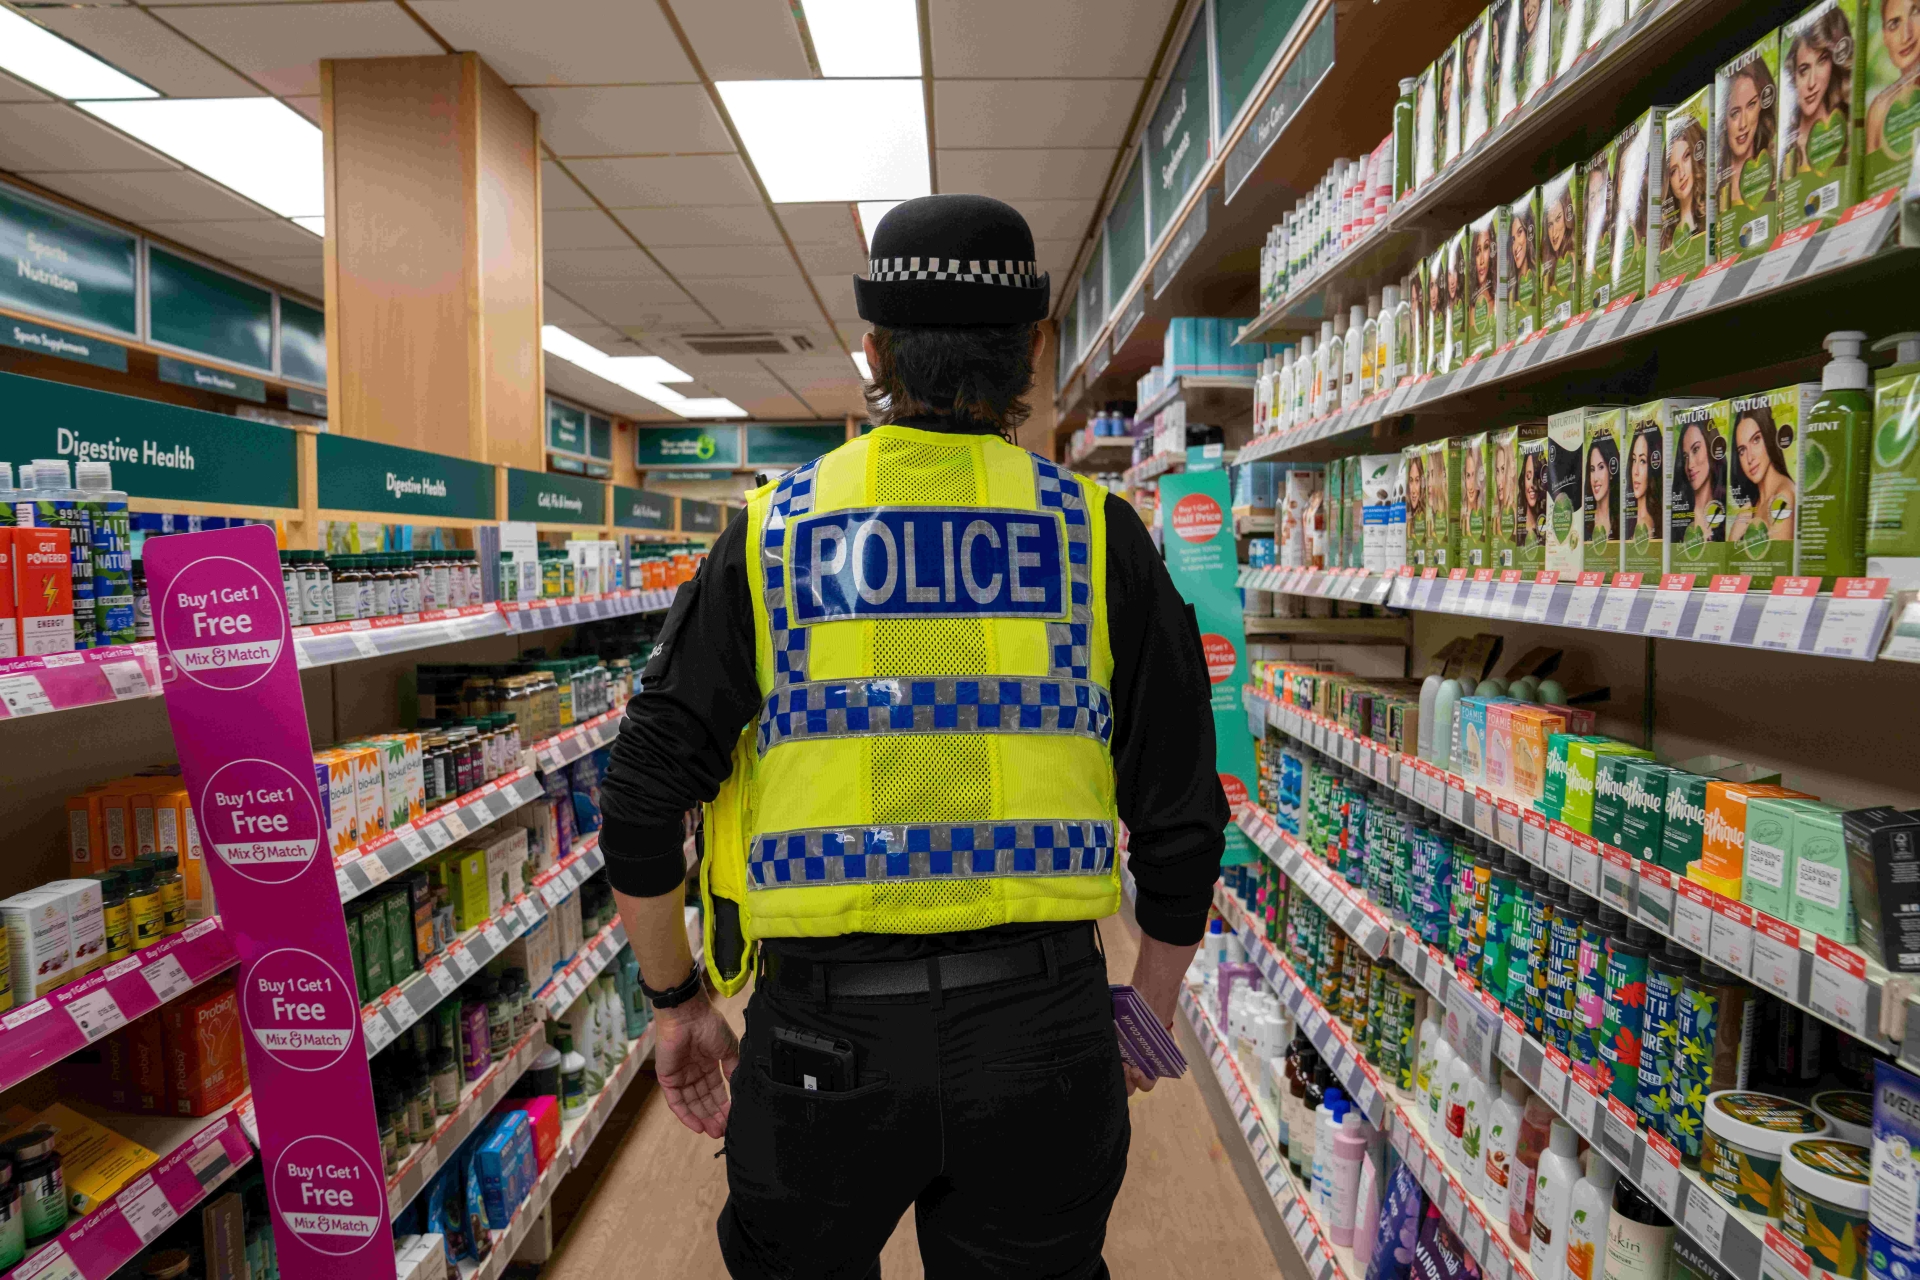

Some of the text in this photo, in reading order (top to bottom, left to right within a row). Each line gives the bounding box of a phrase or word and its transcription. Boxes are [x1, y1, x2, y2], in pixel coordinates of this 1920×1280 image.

[26, 232, 68, 263] Sports
[17, 259, 78, 294] Nutrition
[13, 327, 89, 357] Sports Supplements
[1731, 390, 1794, 414] NATURTINT
[1674, 405, 1727, 426] NATURTINT
[57, 427, 195, 470] Digestive Health
[386, 472, 446, 498] Digestive Health
[1173, 512, 1221, 524] Half Price
[39, 542, 56, 552] GUT
[27, 553, 67, 564] POWERED
[95, 554, 132, 570] NATUR
[811, 519, 1046, 607] POLICE
[1783, 579, 1789, 587] 2
[1789, 578, 1798, 587] for
[1847, 581, 1854, 589] 2
[1854, 580, 1864, 589] for
[178, 585, 259, 611] Buy 1 Get 1
[37, 618, 65, 628] ENERGY
[193, 612, 253, 638] Free
[31, 660, 44, 668] Free
[90, 653, 102, 661] Buy
[107, 651, 117, 659] Get
[120, 649, 133, 657] Free
[186, 646, 270, 667] Mix & Match
[1209, 652, 1235, 663] Price
[1462, 707, 1483, 722] FOAMIE
[1488, 713, 1511, 729] FOAMIE
[1513, 720, 1538, 737] FOAMIE
[1546, 747, 1568, 779] ethiqu
[358, 774, 380, 790] bio-kult
[388, 766, 406, 780] bio-kult
[1566, 763, 1593, 796] ethique
[215, 787, 294, 808] Buy 1 Get 1
[331, 783, 353, 800] bio-kult
[1622, 776, 1661, 814] ethique
[1665, 787, 1705, 826] ethique
[232, 810, 290, 834] Free
[1704, 807, 1745, 850] ethique
[228, 843, 308, 862] Mix & Match
[1750, 845, 1781, 862] CLEANSING
[1750, 853, 1775, 868] SOAP BAR
[1800, 872, 1831, 888] SOAP BAR
[1801, 864, 1838, 882] CLEANSING
[364, 905, 384, 923] Probio7
[1551, 942, 1576, 960] AITH
[1579, 949, 1599, 969] ITH
[57, 990, 73, 1002] Buy
[77, 984, 88, 994] Get
[91, 976, 105, 987] Free
[258, 978, 332, 993] Buy 1 Get 1
[1548, 973, 1573, 990] ATURE
[1606, 970, 1626, 989] ITH
[199, 995, 235, 1023] Probio7
[272, 998, 326, 1021] Free
[1553, 1008, 1571, 1019] WASH
[1602, 1000, 1622, 1024] TURE
[1644, 995, 1667, 1018] ITH
[266, 1030, 342, 1048] Mix & Match
[177, 1049, 187, 1090] Probio7
[1640, 1070, 1661, 1085] WASH
[1714, 1143, 1740, 1164] FAITH
[158, 1163, 171, 1174] Buy
[288, 1164, 360, 1180] Buy 1 Get 1
[1713, 1165, 1739, 1184] NATURE
[1881, 1161, 1907, 1181] RELAX
[301, 1182, 354, 1207] Free
[69, 1229, 85, 1241] Buy
[88, 1217, 100, 1229] Get
[104, 1203, 118, 1216] Free
[295, 1215, 370, 1233] Mix & Match
[1608, 1224, 1640, 1254] sukin
[1673, 1241, 1720, 1280] MANCAVE
